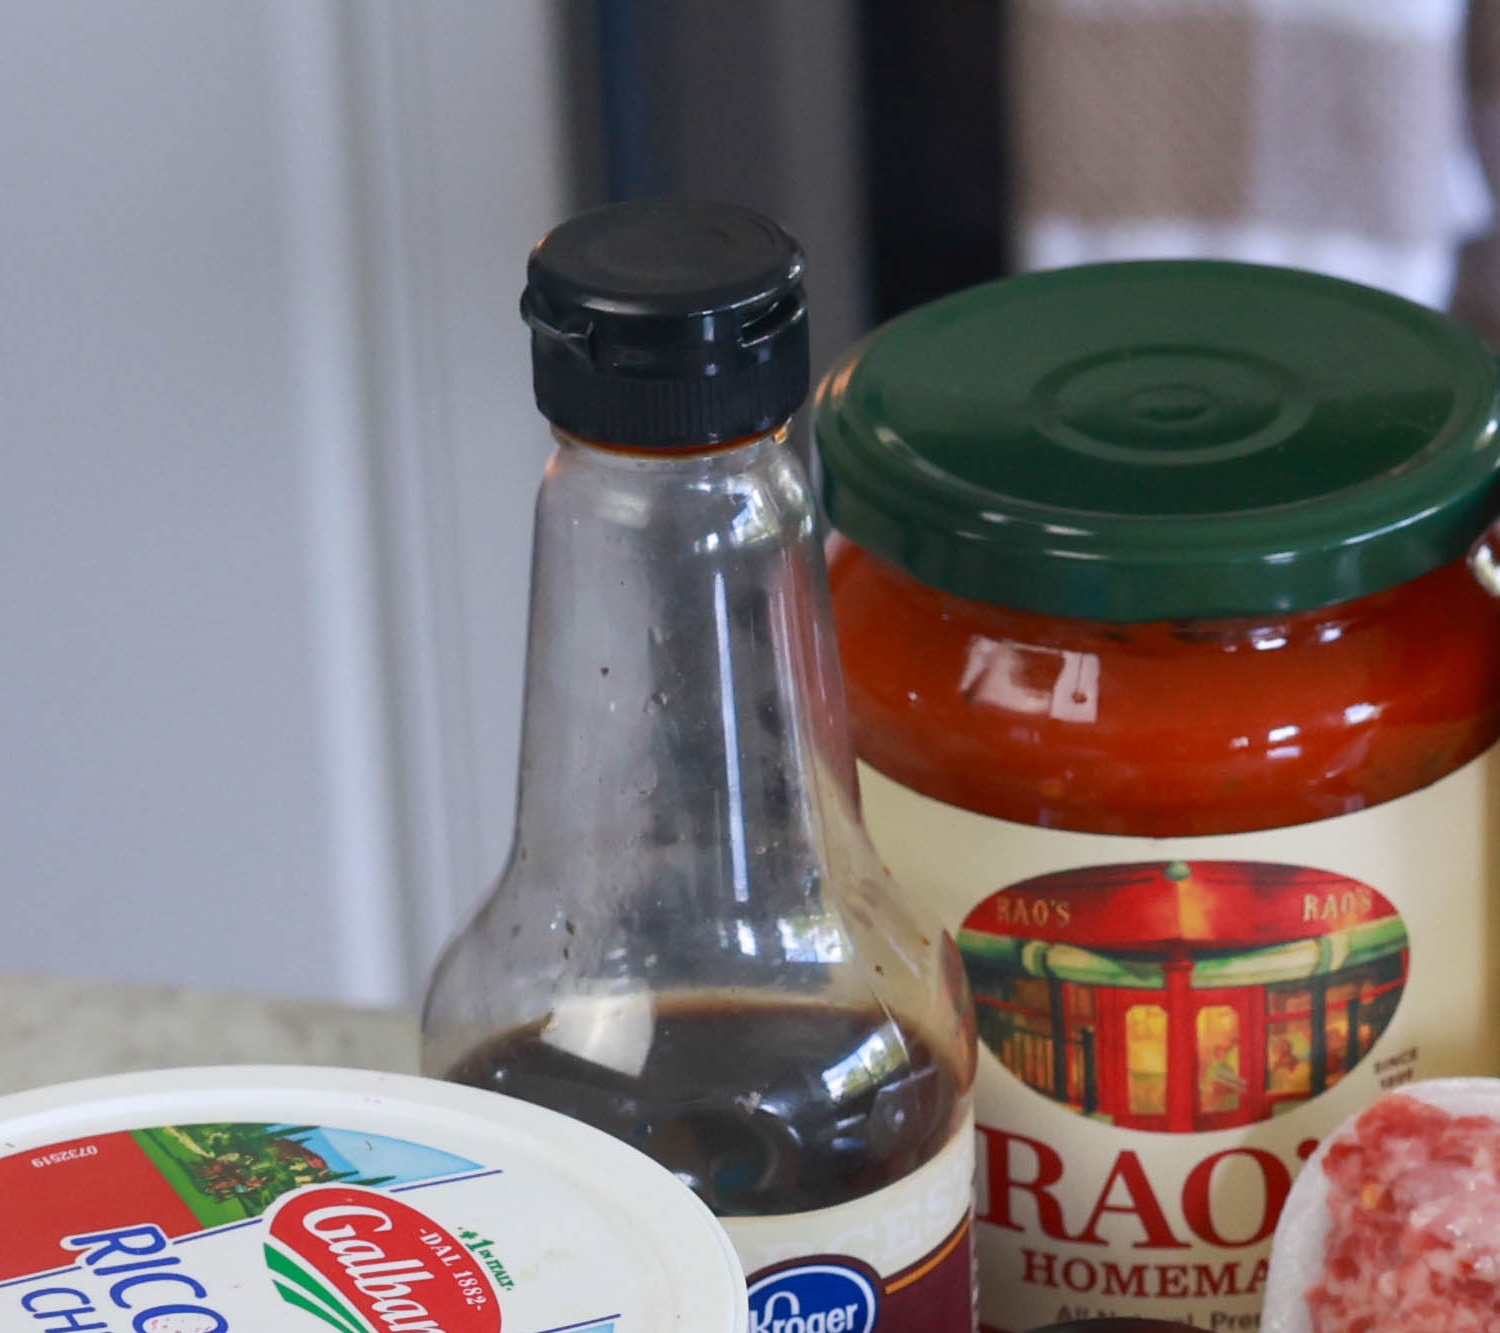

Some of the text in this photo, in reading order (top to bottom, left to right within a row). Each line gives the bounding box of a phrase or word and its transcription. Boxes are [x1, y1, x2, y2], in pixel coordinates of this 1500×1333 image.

[998, 897, 1071, 928] RAO'S
[1303, 886, 1373, 922] RAO'S
[975, 1122, 1320, 1254] RAO'
[1020, 1249, 1270, 1299] HOMEMA
